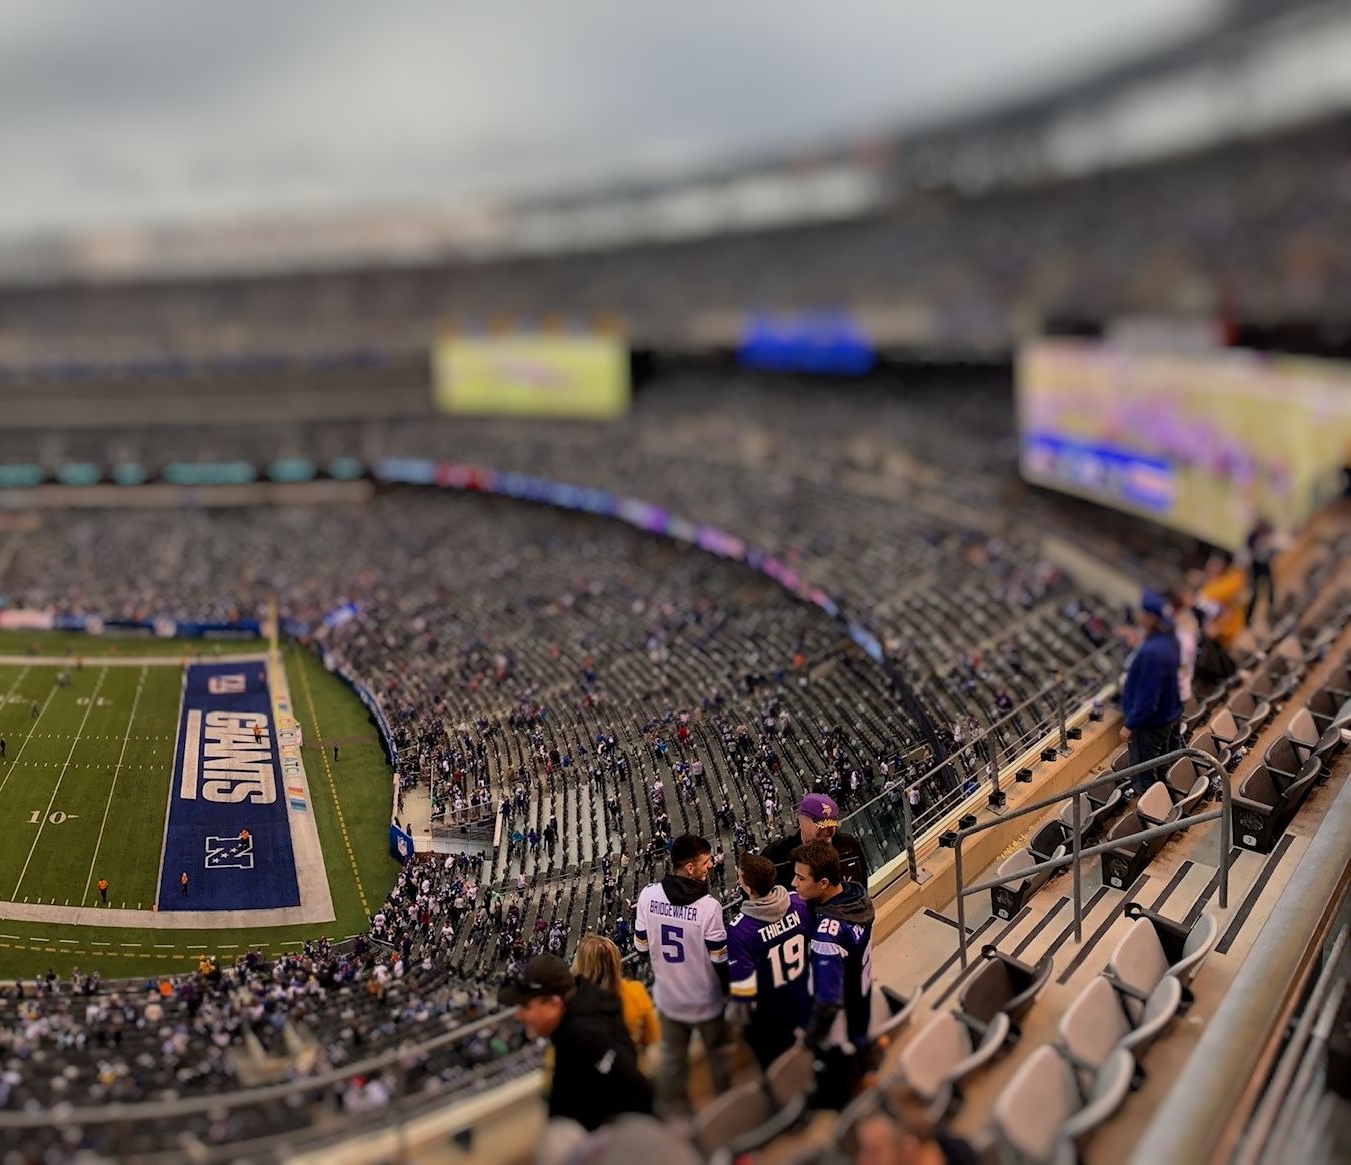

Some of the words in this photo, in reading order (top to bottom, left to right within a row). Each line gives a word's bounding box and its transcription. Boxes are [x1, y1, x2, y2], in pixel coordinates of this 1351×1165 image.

[202, 710, 277, 804] GIANTS
[27, 810, 67, 824] 10
[650, 900, 697, 921] BRIDGEWATER
[757, 910, 801, 942] THIELEN
[817, 918, 840, 936] 28
[661, 924, 685, 963] 5
[767, 934, 805, 989] 19
